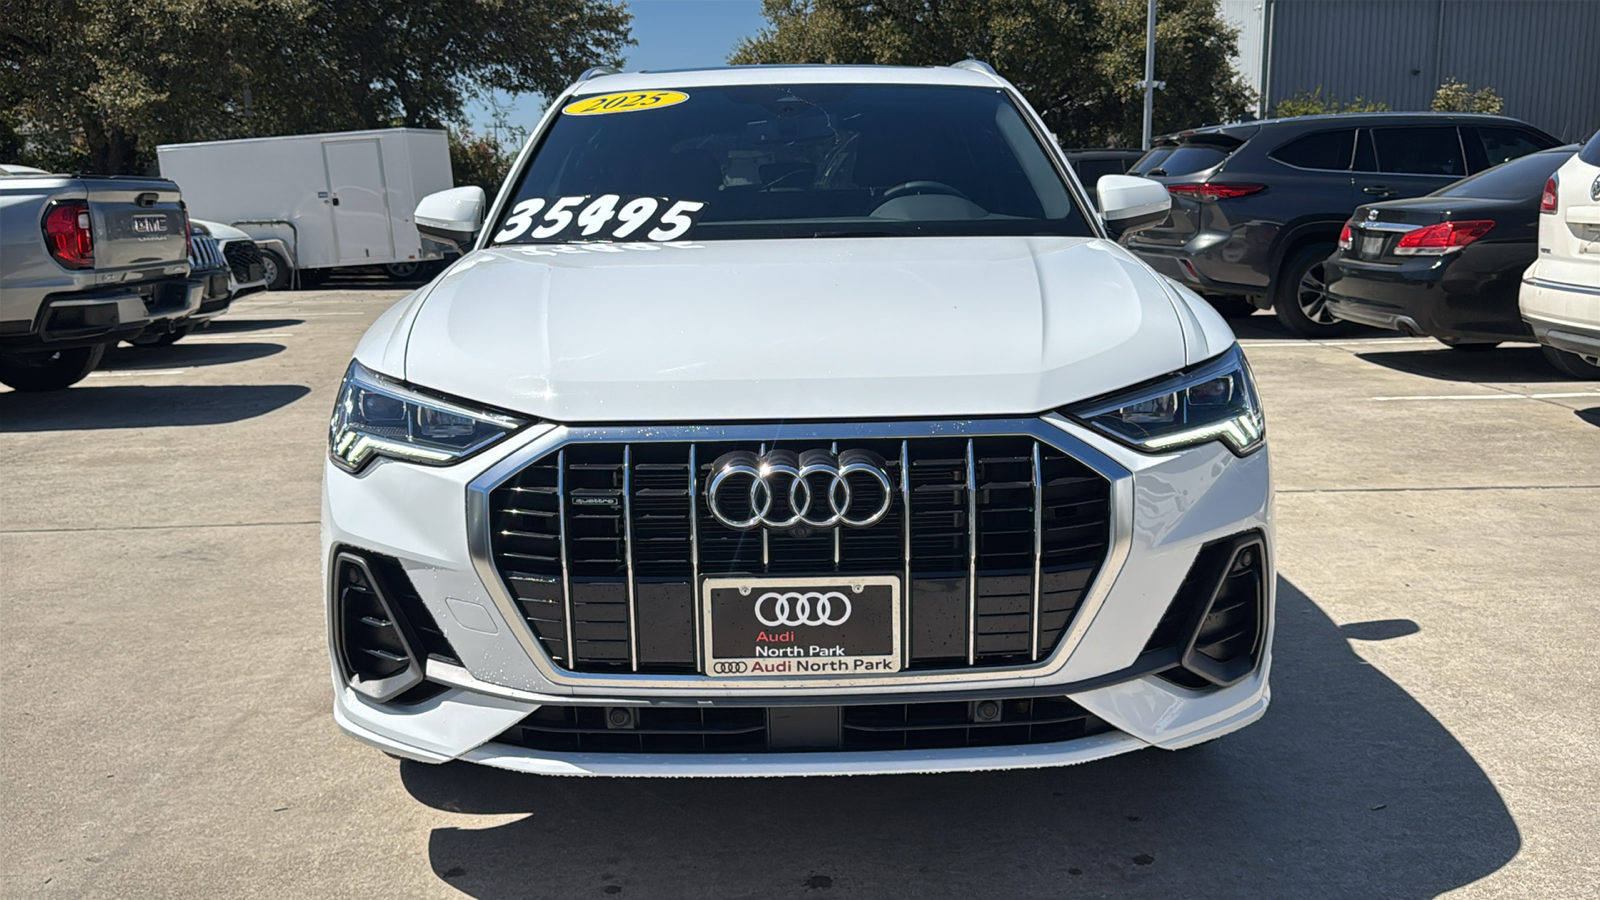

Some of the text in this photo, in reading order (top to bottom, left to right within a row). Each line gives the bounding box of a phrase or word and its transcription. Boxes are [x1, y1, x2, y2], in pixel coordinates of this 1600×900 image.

[580, 93, 669, 112] 2025
[133, 214, 167, 232] GMC
[494, 194, 704, 243] 35495
[756, 631, 795, 642] Audi
[755, 645, 845, 657] North Park
[751, 659, 893, 673] Audi North Park
